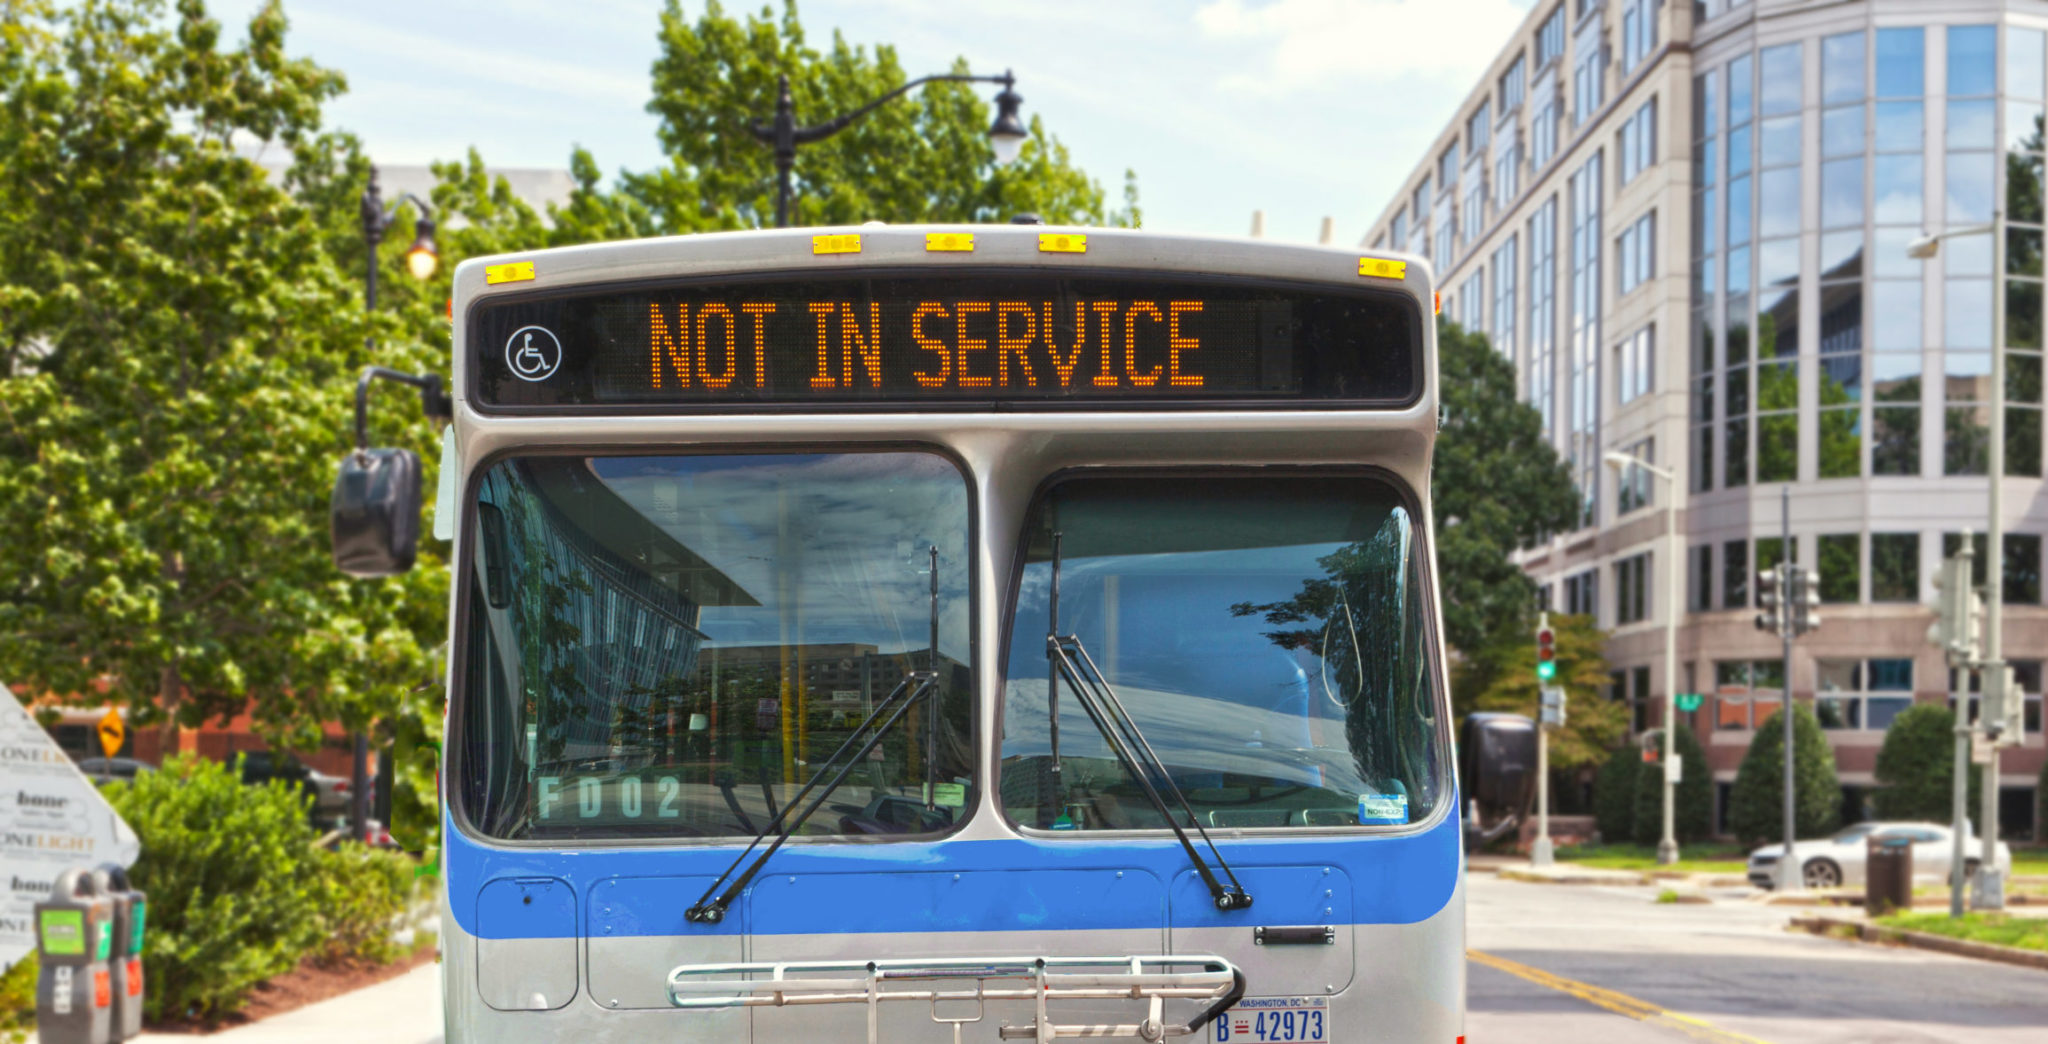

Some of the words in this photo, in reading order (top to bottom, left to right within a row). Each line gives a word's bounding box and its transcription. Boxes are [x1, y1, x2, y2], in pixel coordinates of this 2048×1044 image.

[651, 302, 776, 389] NOT
[809, 302, 881, 389] IN
[912, 301, 1204, 388] SERVICE
[1290, 998, 1300, 1007] DC
[1217, 1012, 1229, 1042] B
[1255, 1010, 1323, 1041] 42973
